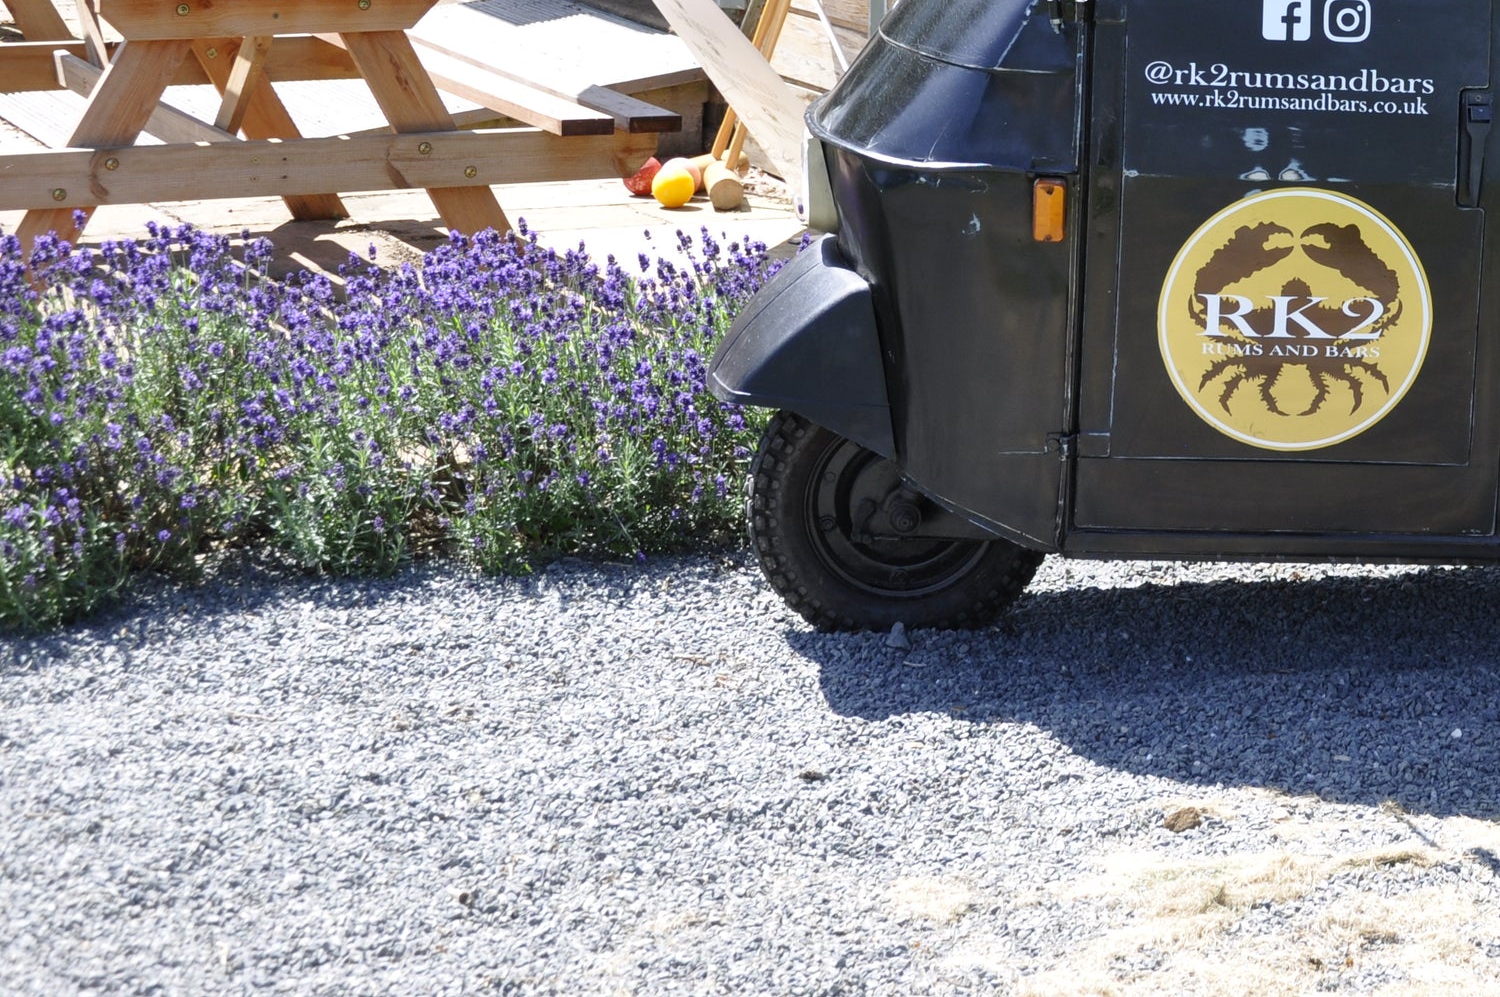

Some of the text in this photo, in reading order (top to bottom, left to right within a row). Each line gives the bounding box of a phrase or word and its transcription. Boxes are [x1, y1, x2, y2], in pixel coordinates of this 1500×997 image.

[1144, 60, 1436, 96] @rk2rumsandbars
[1151, 89, 1430, 116] www.rk2rumsandbars.co.uk
[1196, 292, 1385, 341] RK2
[1201, 341, 1381, 359] RUMS AND BARS
